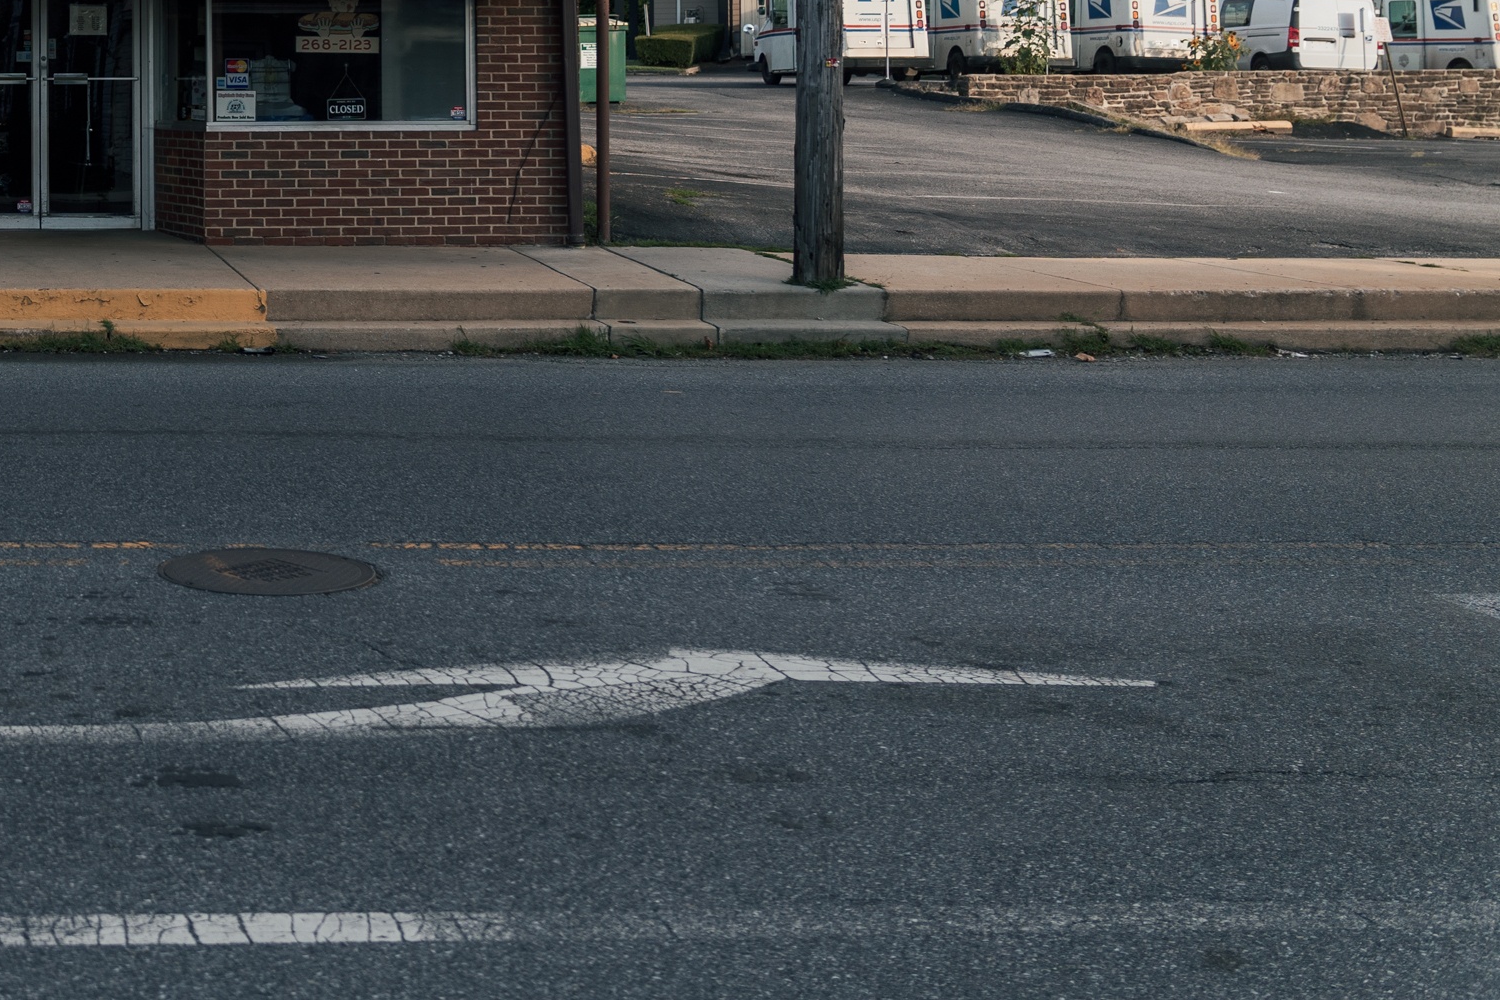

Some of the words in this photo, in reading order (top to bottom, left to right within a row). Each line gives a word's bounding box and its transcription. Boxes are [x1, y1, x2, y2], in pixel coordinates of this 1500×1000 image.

[301, 39, 372, 50] 268-2123
[229, 76, 247, 84] VISA
[329, 104, 364, 114] CLOSED
